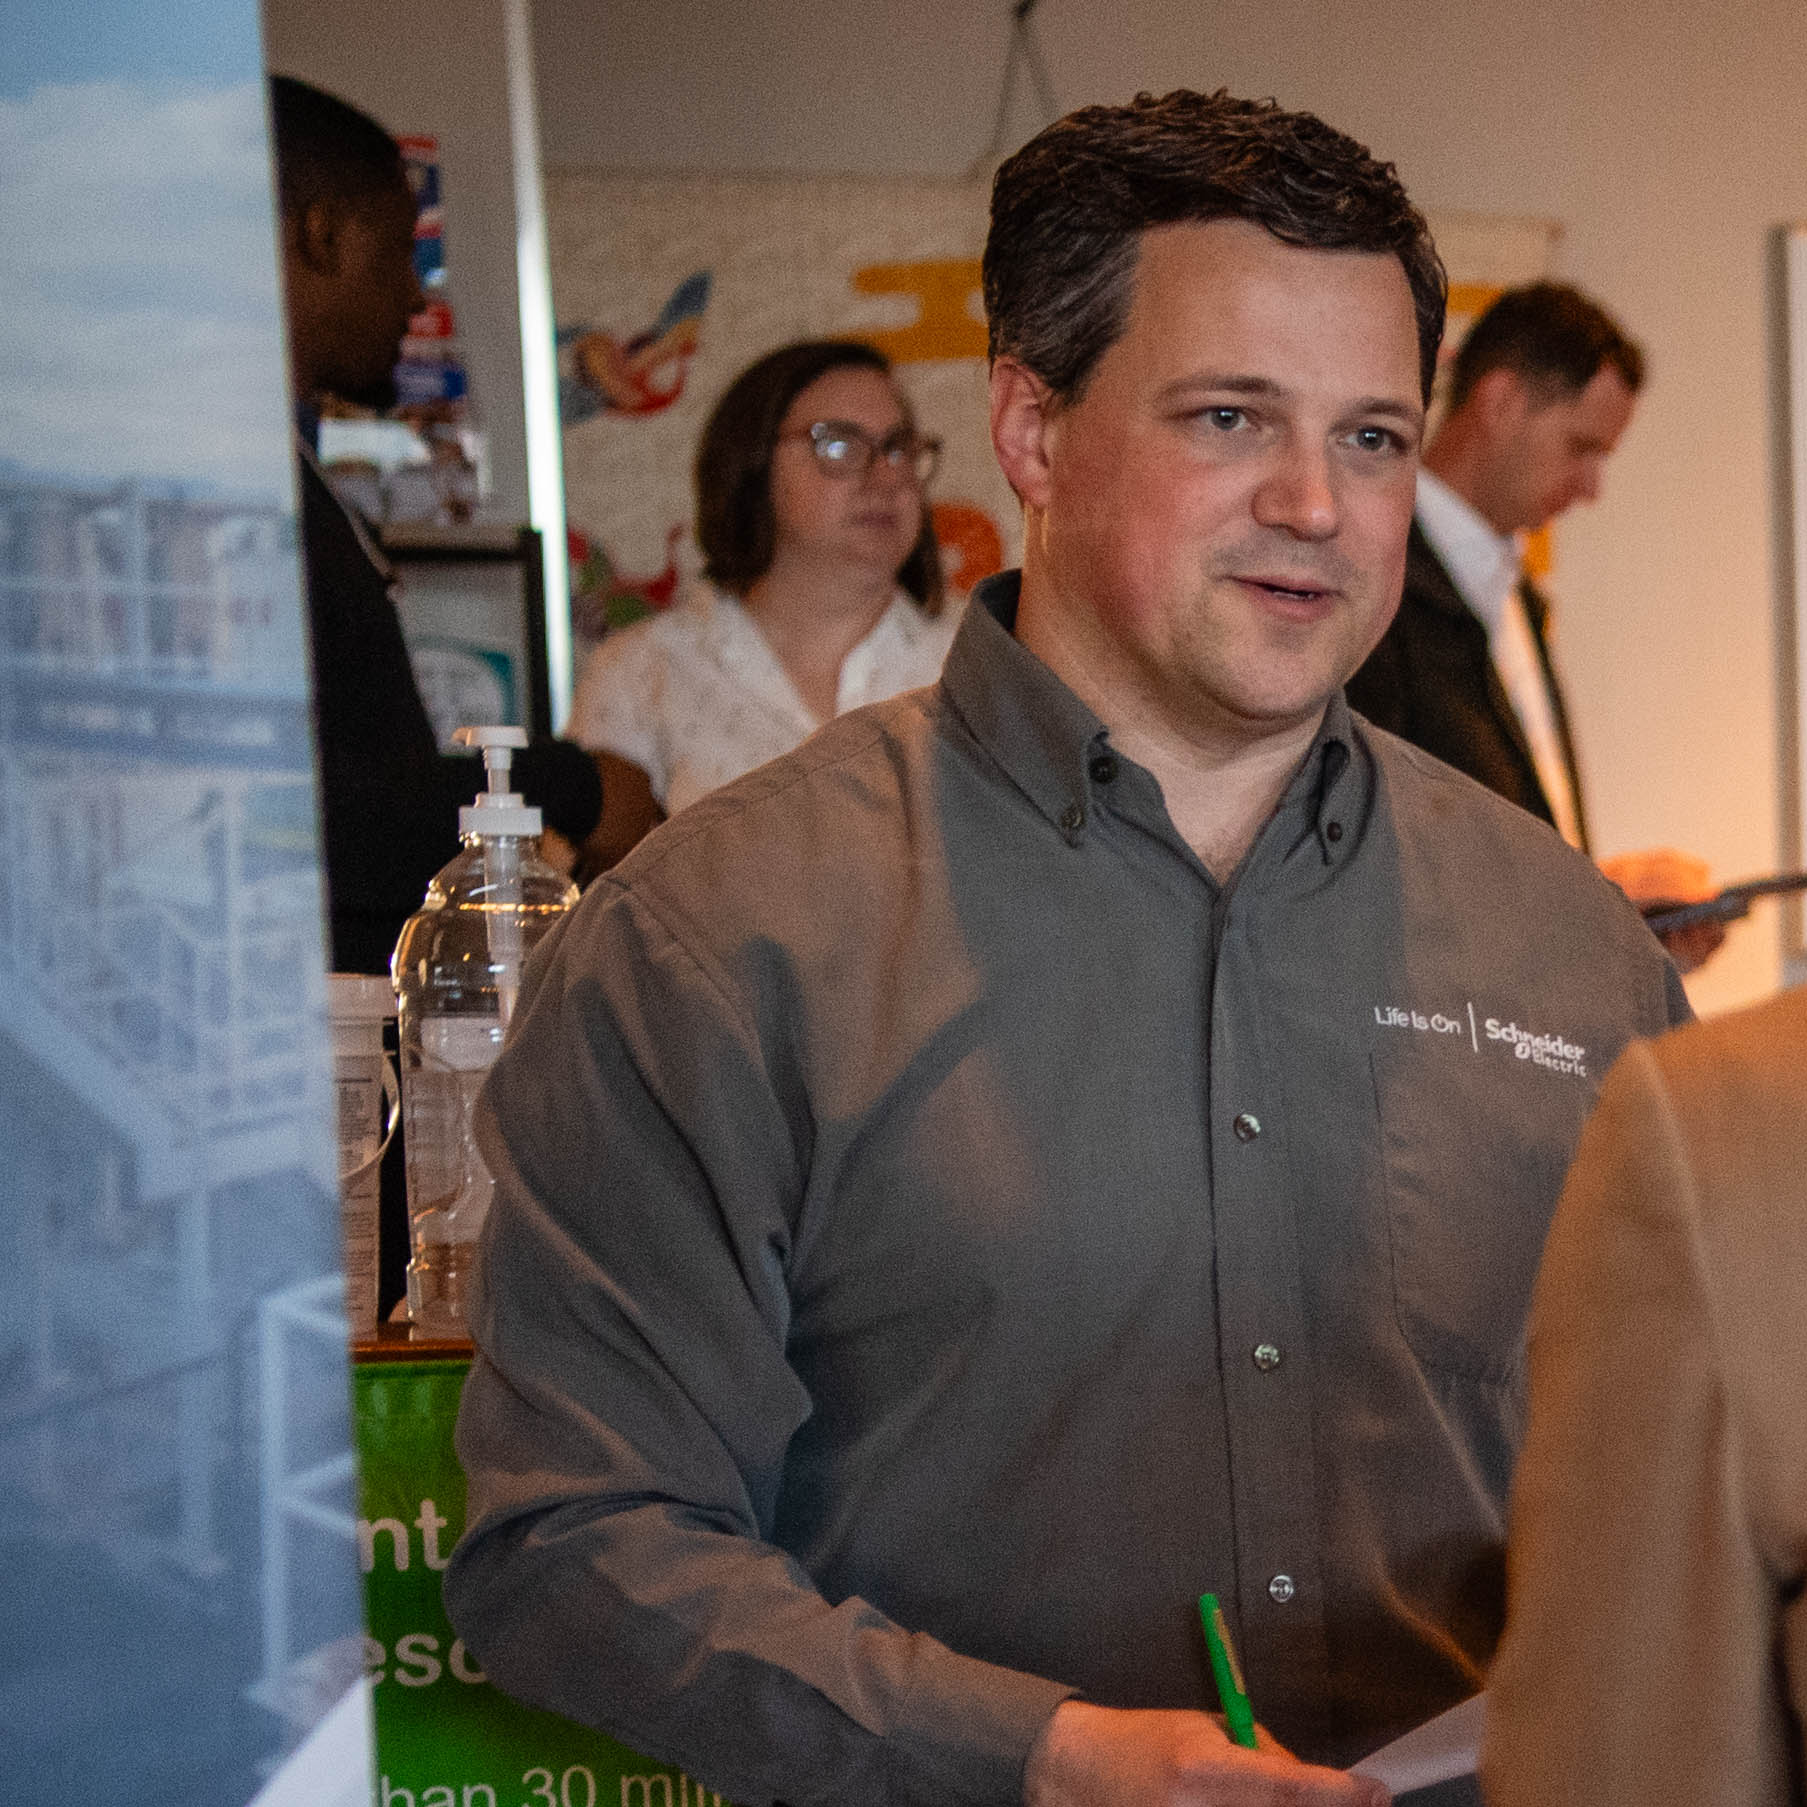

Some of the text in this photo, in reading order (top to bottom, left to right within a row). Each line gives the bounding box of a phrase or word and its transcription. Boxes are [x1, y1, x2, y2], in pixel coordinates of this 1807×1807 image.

[1374, 1006, 1409, 1028] Life
[1430, 1013, 1462, 1035] On
[1485, 1018, 1585, 1061] Schneider
[1532, 1052, 1588, 1078] Electric
